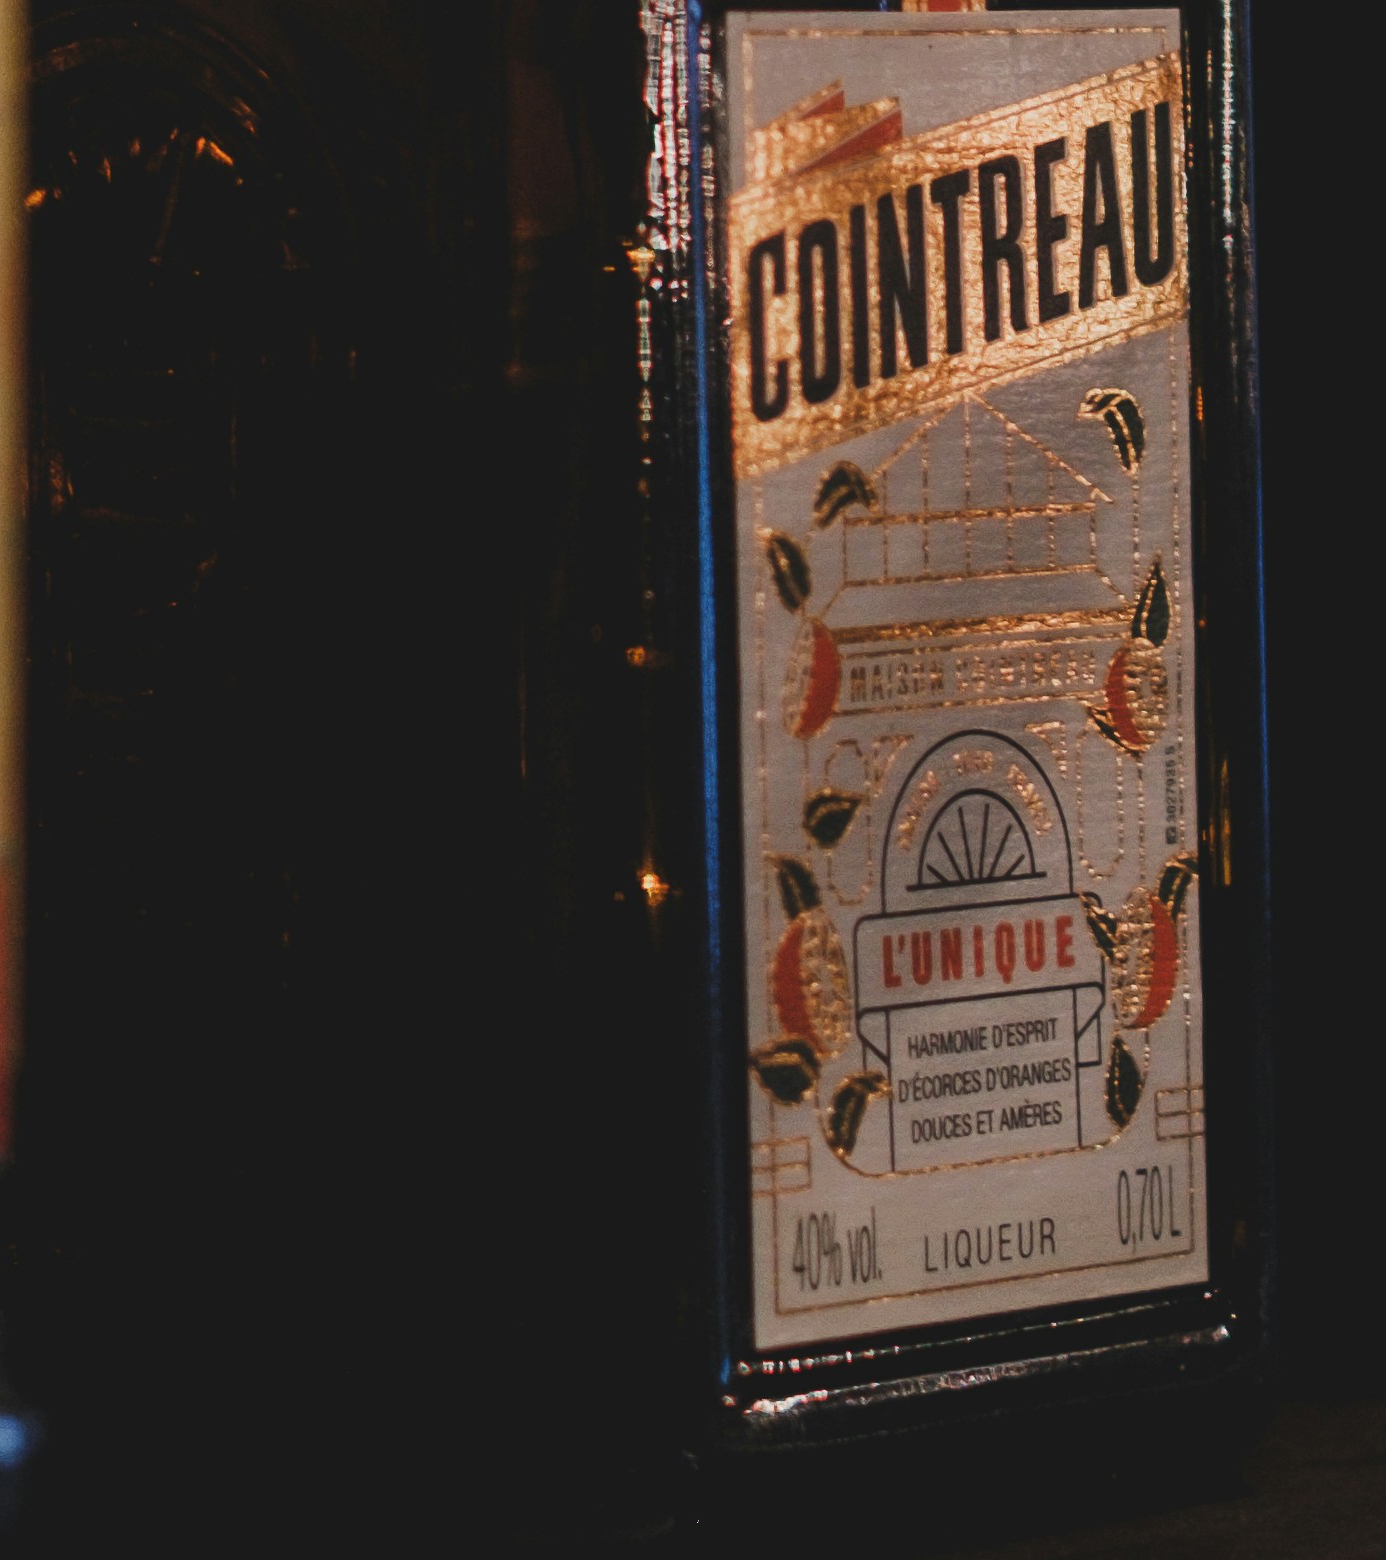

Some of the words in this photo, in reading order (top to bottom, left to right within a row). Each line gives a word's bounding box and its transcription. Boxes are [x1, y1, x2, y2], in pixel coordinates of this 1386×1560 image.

[747, 101, 1175, 423] COINTREAU
[881, 914, 1077, 989] L'UNIQUE
[907, 1024, 988, 1059] HARMONIE
[992, 1017, 1059, 1049] D'ESPRIT
[897, 1071, 982, 1104] D'ÉCORCES
[985, 1057, 1072, 1092] D'ORANGES
[911, 1112, 973, 1144] DOUCES
[976, 1110, 994, 1136] ET
[999, 1099, 1063, 1132] AMÈRES
[1116, 1164, 1164, 1254] 0,70
[1168, 1162, 1183, 1238] L
[792, 1210, 843, 1291] 40%
[848, 1205, 883, 1284] vol.
[924, 1216, 1057, 1273] LIQUEUR
